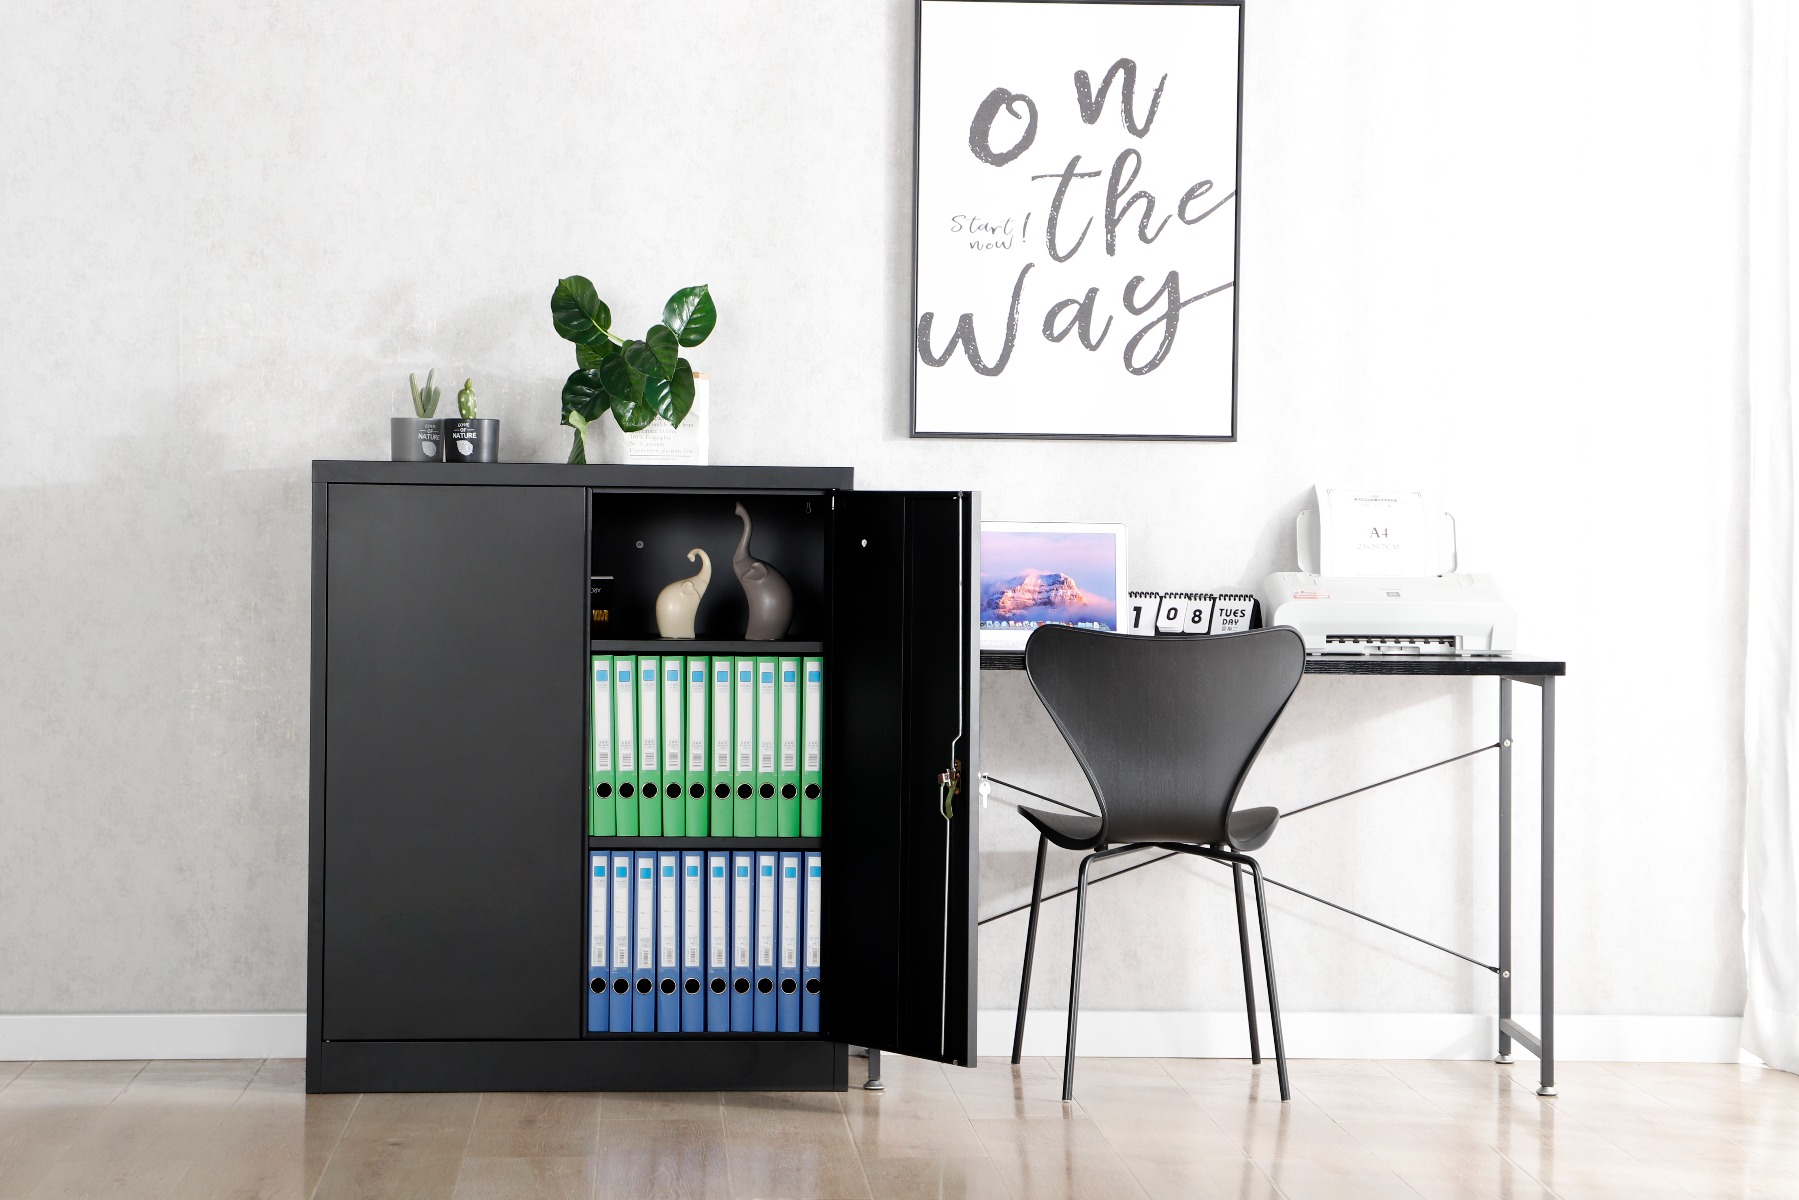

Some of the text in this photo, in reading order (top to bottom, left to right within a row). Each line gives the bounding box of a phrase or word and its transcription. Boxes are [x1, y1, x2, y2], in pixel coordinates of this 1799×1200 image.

[1031, 148, 1236, 262] the
[1369, 527, 1389, 538] A4
[1218, 608, 1246, 618] TUES
[1222, 618, 1239, 626] DAY
